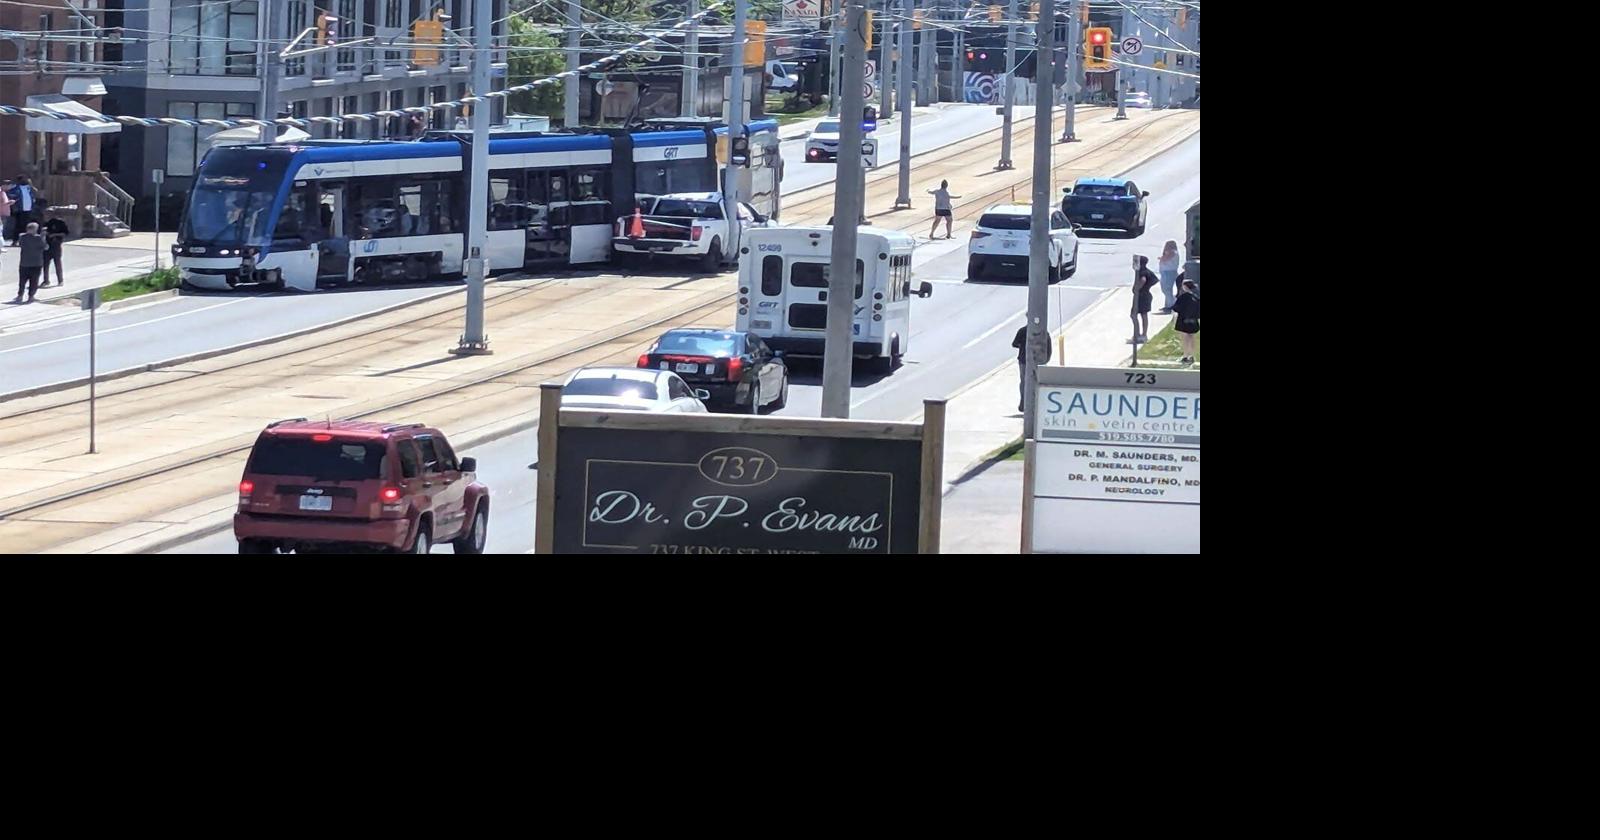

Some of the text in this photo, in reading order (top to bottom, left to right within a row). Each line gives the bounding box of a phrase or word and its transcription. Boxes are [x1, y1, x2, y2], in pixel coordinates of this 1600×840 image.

[1124, 373, 1156, 385] 723
[1044, 415, 1077, 427] skin
[1102, 418, 1136, 431] vein
[1073, 449, 1199, 464] DR. M. SAUNDERS, MD.
[711, 455, 765, 480] 737
[1088, 462, 1183, 473] GENERAL SURGERY
[1068, 473, 1088, 483] DR.
[1090, 475, 1100, 484] P.
[1102, 475, 1182, 488] MANDALFINO,
[1104, 486, 1165, 496] NEUROLOGY
[589, 490, 883, 532] Dr. P. Evans
[848, 536, 879, 550] MD
